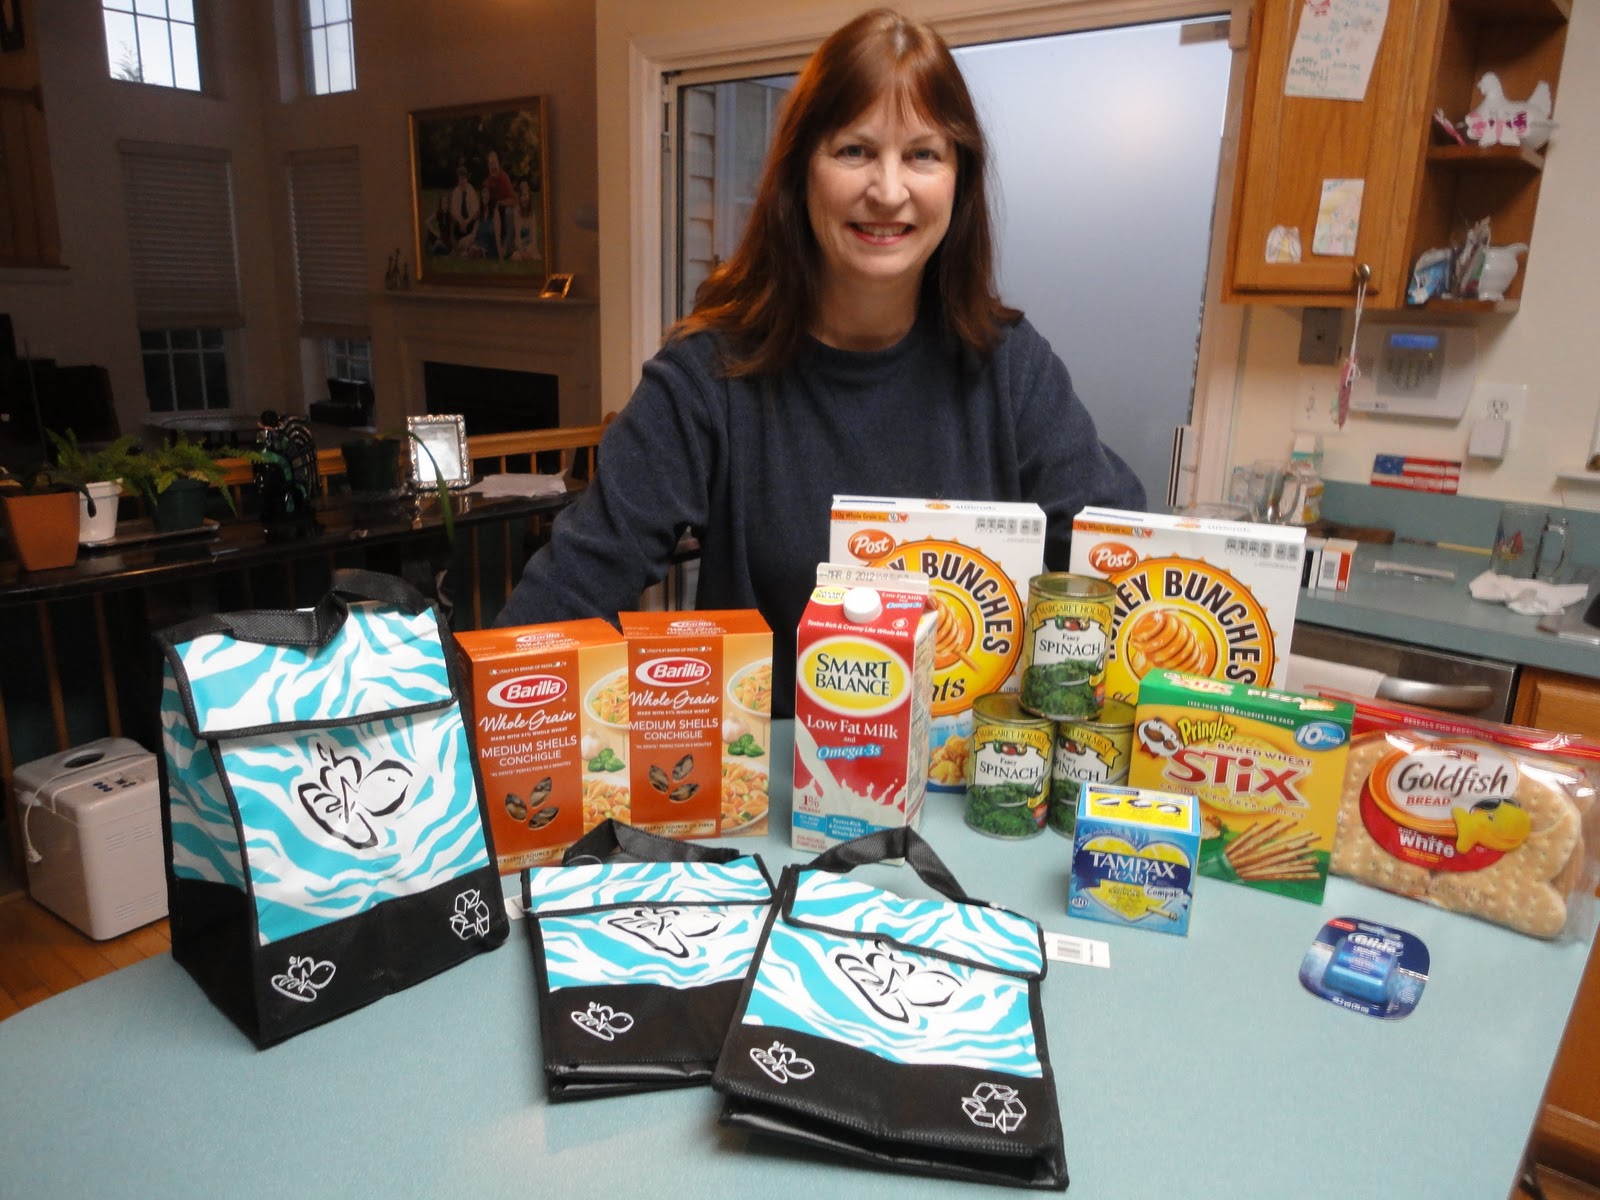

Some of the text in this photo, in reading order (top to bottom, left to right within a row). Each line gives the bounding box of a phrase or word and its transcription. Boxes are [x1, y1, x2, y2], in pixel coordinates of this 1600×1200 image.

[854, 535, 890, 554] Post
[1096, 547, 1132, 567] Post
[827, 569, 843, 580] MAR
[846, 570, 851, 579] 8
[856, 572, 875, 582] 2012
[921, 552, 1013, 655] BUNCHES
[807, 619, 824, 628] Tastes
[825, 621, 837, 629] Rich
[843, 623, 864, 633] Creamy
[864, 626, 876, 634] Like
[877, 627, 896, 636] Whole
[896, 629, 909, 637] Milk
[1163, 568, 1262, 685] BUNCHES
[1062, 633, 1080, 642] Fancy
[1039, 639, 1101, 657] SPINACH
[653, 663, 706, 679] Barilla
[816, 653, 892, 679] SMART
[506, 679, 561, 700] Barilla
[815, 673, 890, 697] BALANCE
[628, 690, 719, 710] Whole Grain
[1187, 700, 1201, 708] LESS
[1202, 702, 1218, 711] THAN
[1220, 704, 1235, 714] 100
[1236, 708, 1265, 719] CALORIES
[479, 709, 577, 732] Whole Grain
[628, 718, 719, 731] MEDIUM SHELLS
[806, 714, 898, 739] Low Fat Milk
[532, 729, 550, 737] WHOLE
[551, 726, 568, 735] WHEAT
[644, 730, 703, 740] CONCHIGLIE
[843, 735, 856, 743] and
[1177, 715, 1235, 748] Pringles
[1297, 722, 1322, 741] 10
[481, 735, 578, 758] MEDIUM SHELLS
[1217, 741, 1314, 767] BAKED WHEAT
[499, 750, 562, 767] CONCHIGLIE
[1000, 757, 1017, 766] Fancy
[1062, 753, 1077, 763] Fancy
[979, 762, 1040, 779] SPINACH
[1397, 761, 1509, 797] Goldfish
[803, 795, 820, 808] 1%
[1406, 795, 1451, 806] BREAD
[526, 850, 552, 859] SOURCE
[1399, 832, 1455, 858] White
[1089, 851, 1176, 880] TAMPAX
